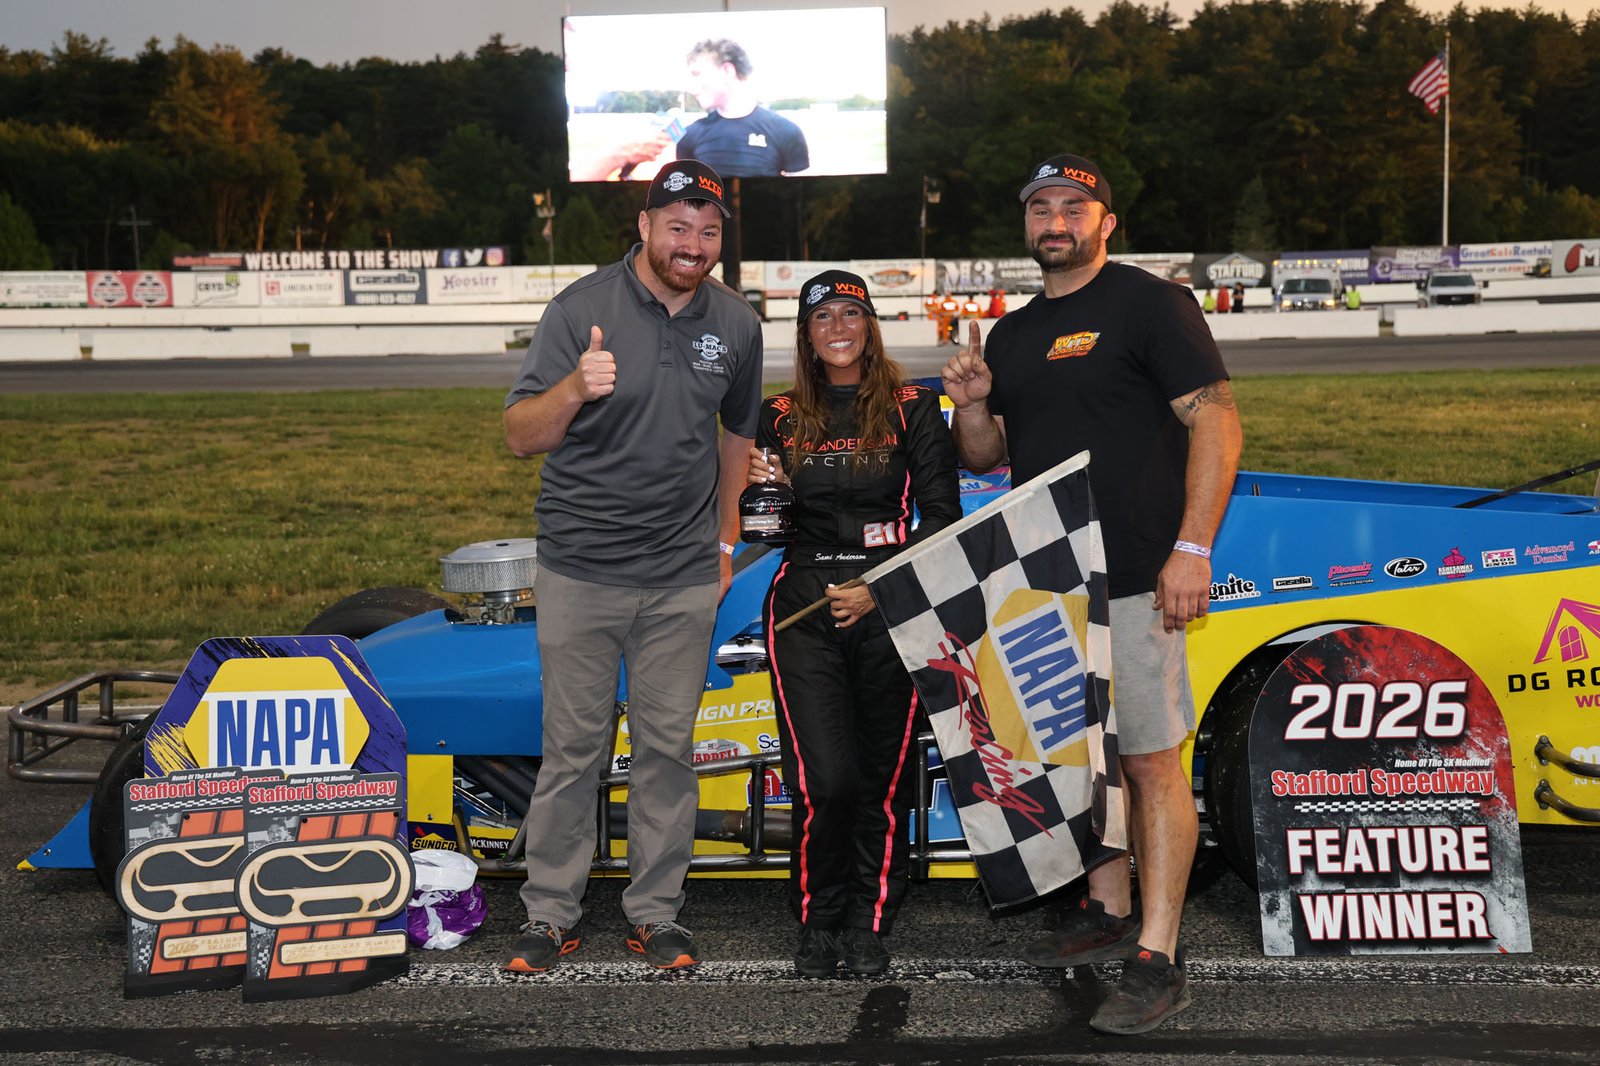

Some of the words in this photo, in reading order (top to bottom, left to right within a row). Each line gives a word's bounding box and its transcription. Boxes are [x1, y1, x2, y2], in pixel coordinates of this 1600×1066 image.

[1063, 166, 1097, 184] WTD
[698, 175, 723, 195] WTD
[245, 251, 324, 270] WELCOME
[329, 251, 350, 269] TO
[353, 250, 385, 268] THE
[388, 250, 438, 268] SHOW
[1208, 263, 1265, 280] STAFFORD
[835, 282, 865, 295] WTD
[1055, 333, 1094, 350] WTD
[864, 521, 898, 548] 21
[1524, 541, 1575, 556] Advanced
[1533, 552, 1568, 564] Dental
[1328, 562, 1373, 579] Phoenix
[1208, 574, 1254, 600] gnite
[1219, 591, 1260, 600] MARKETING
[998, 609, 1087, 751] NAPA
[1508, 672, 1550, 692] DG
[740, 698, 776, 716] PR
[1284, 681, 1468, 740] 2026
[217, 698, 341, 767] NAPA
[692, 747, 738, 763] ADDELL
[1394, 759, 1417, 768] Home
[1418, 759, 1428, 767] Of
[1428, 759, 1442, 767] The
[1443, 759, 1454, 767] SK
[1455, 758, 1490, 767] Modified
[212, 771, 236, 779] Modified
[330, 774, 354, 782] Modified
[1271, 769, 1367, 796] Stafford
[1371, 768, 1495, 796] Speedway
[130, 780, 195, 801] Stafford
[198, 776, 280, 796] Speed
[249, 783, 314, 804] Stafford
[316, 780, 397, 800] Speedway
[412, 839, 457, 850] SUNOCO
[1285, 826, 1491, 874] FEATURE
[1298, 892, 1495, 941] WINNER
[168, 939, 199, 956] 2026
